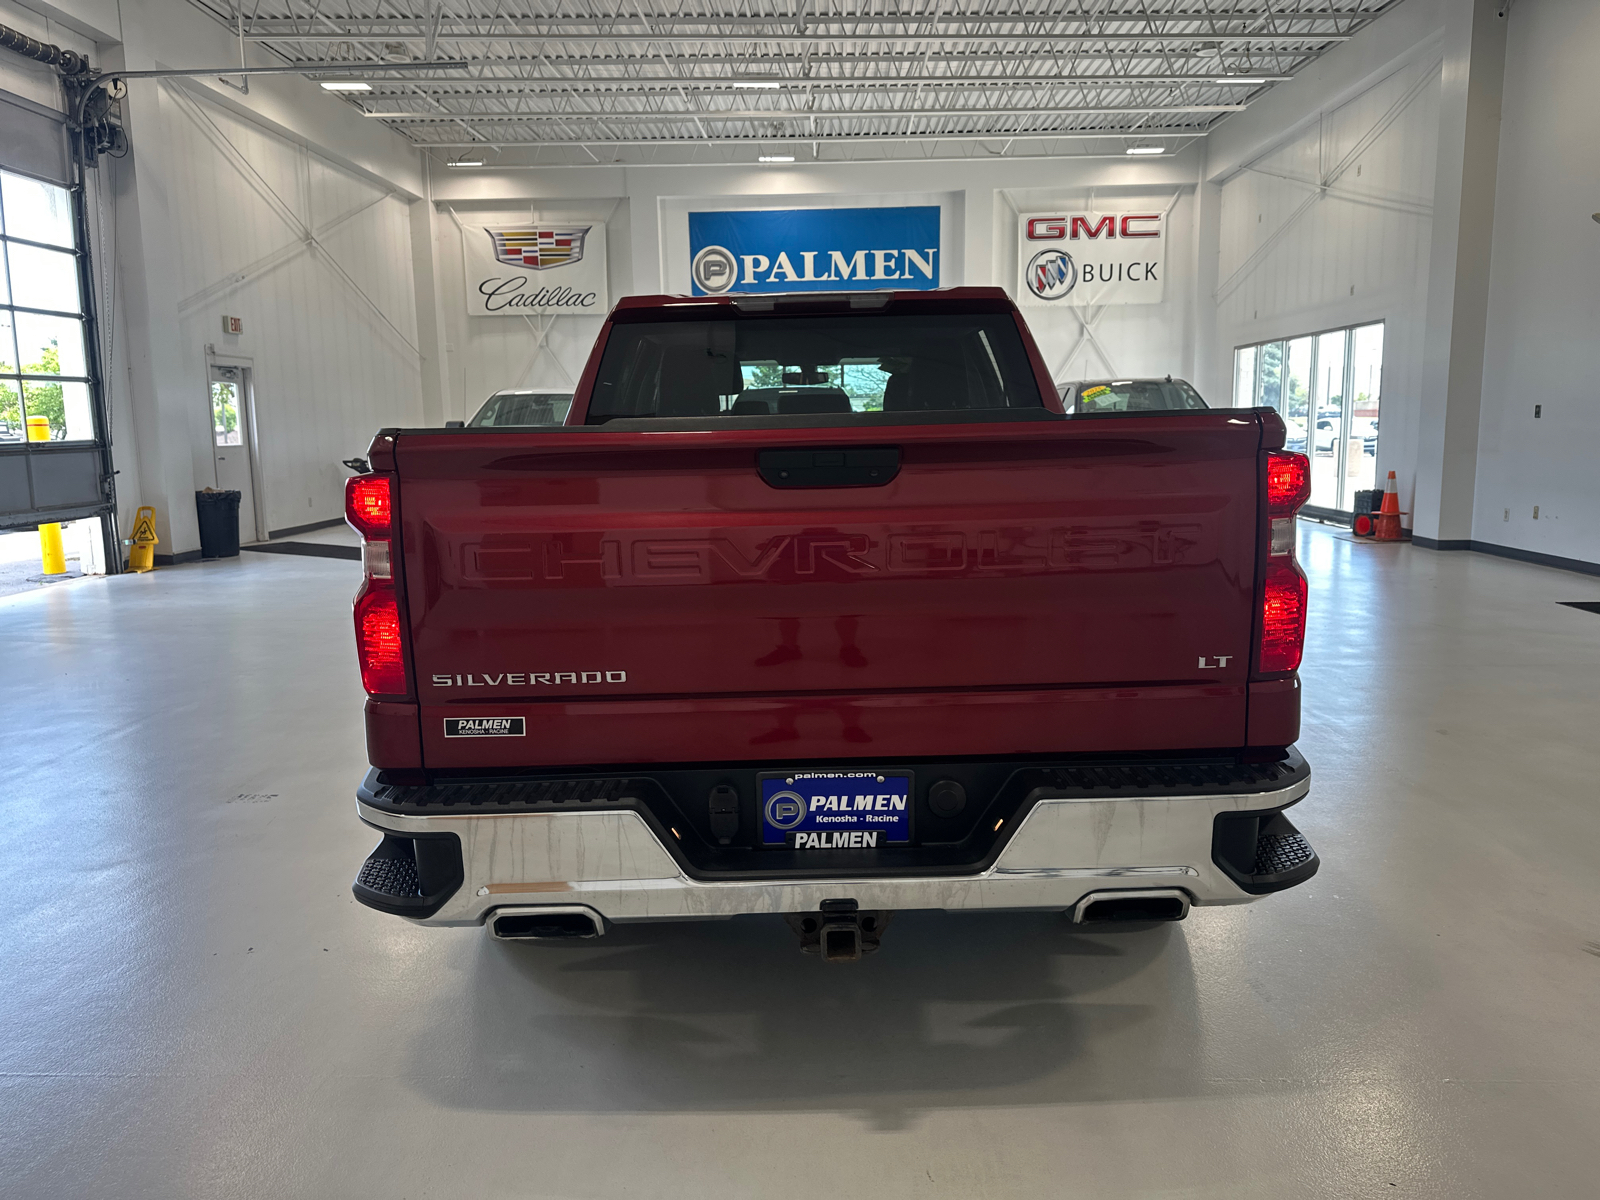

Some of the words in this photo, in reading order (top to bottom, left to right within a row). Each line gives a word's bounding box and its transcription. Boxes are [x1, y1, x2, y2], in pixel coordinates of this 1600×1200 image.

[1026, 214, 1161, 241] GMC
[740, 248, 938, 284] PALMEN
[1083, 262, 1158, 282] BUICK
[478, 276, 597, 312] Cadillac
[459, 524, 1201, 580] CHEVROLET
[1198, 655, 1233, 669] LT
[432, 670, 628, 687] SILVERADO
[458, 719, 511, 729] PALMEN
[794, 772, 876, 780] palmen.com
[809, 795, 907, 811] PALMEN
[816, 815, 857, 823] Kenosha
[795, 832, 877, 848] PALMEN
